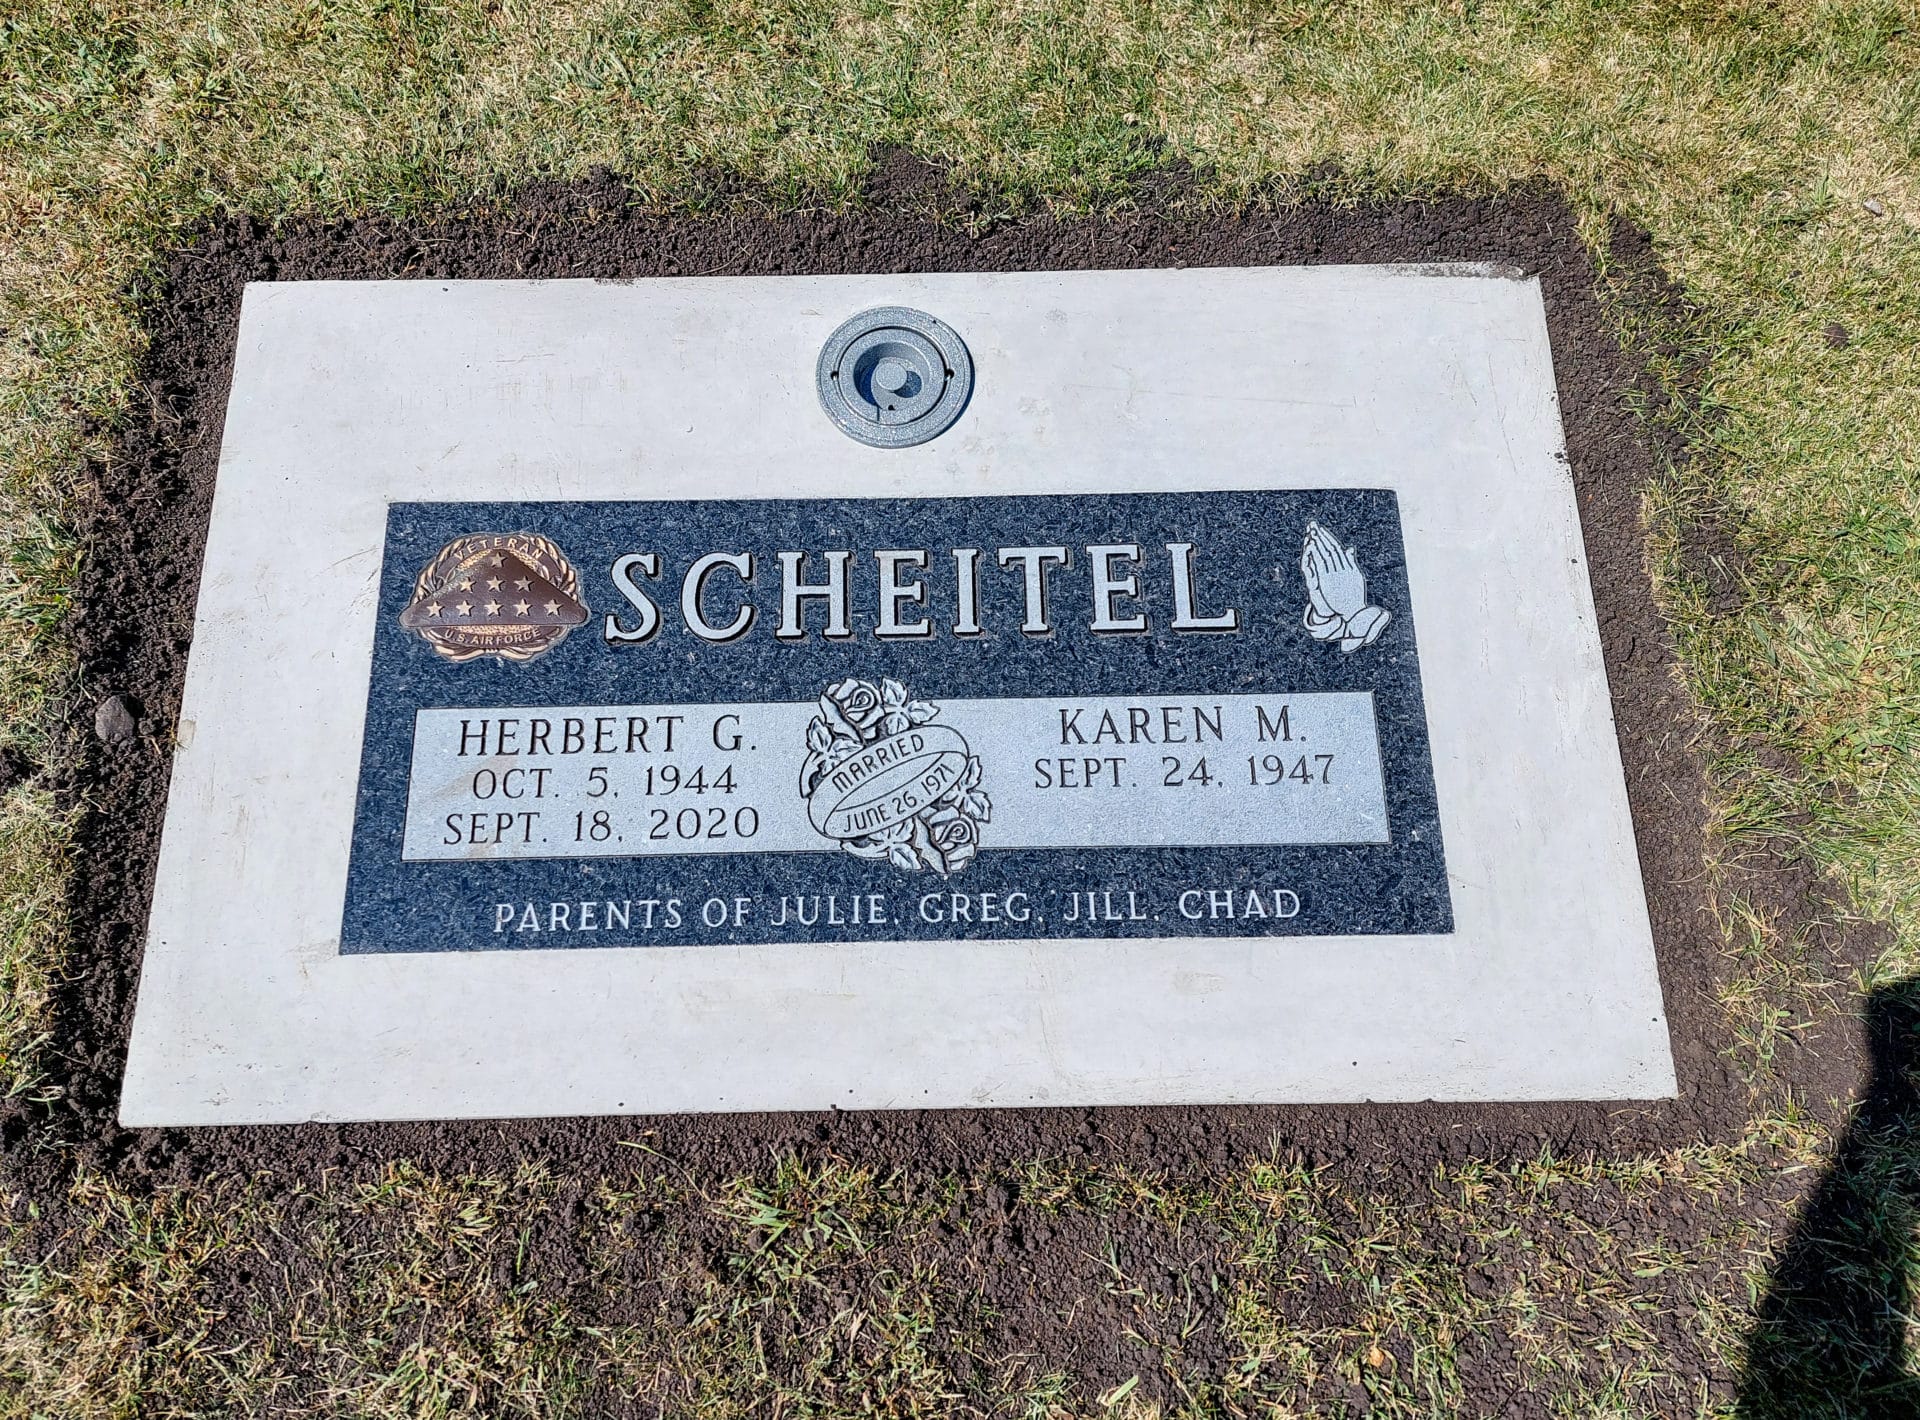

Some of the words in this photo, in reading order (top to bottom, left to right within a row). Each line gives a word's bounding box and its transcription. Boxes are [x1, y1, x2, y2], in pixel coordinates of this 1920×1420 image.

[453, 536, 544, 561] VETERAN
[604, 542, 1237, 642] SCHEITEL
[457, 715, 684, 757] HERBERT
[712, 714, 758, 752] G.
[1058, 706, 1225, 745] KAREN
[1254, 704, 1308, 743] M.
[472, 768, 561, 800] OCT.
[586, 767, 620, 799] 5,
[645, 764, 738, 797] 1944
[831, 733, 925, 794] MARRIED
[1033, 756, 1138, 789] SEPT.
[1161, 755, 1224, 788] 24,
[1247, 754, 1336, 786] 1947
[843, 803, 892, 833] JUNE
[920, 762, 956, 796] 1971
[443, 811, 548, 845] SEPT.
[575, 810, 624, 843] 18,
[649, 806, 760, 841] 2020
[492, 900, 684, 933] PARENTS
[701, 897, 752, 928] OF
[770, 894, 900, 927] JULIE,
[918, 891, 1044, 924] GREG,
[1062, 890, 1161, 922] JILL,
[1178, 889, 1302, 921] CHAD
